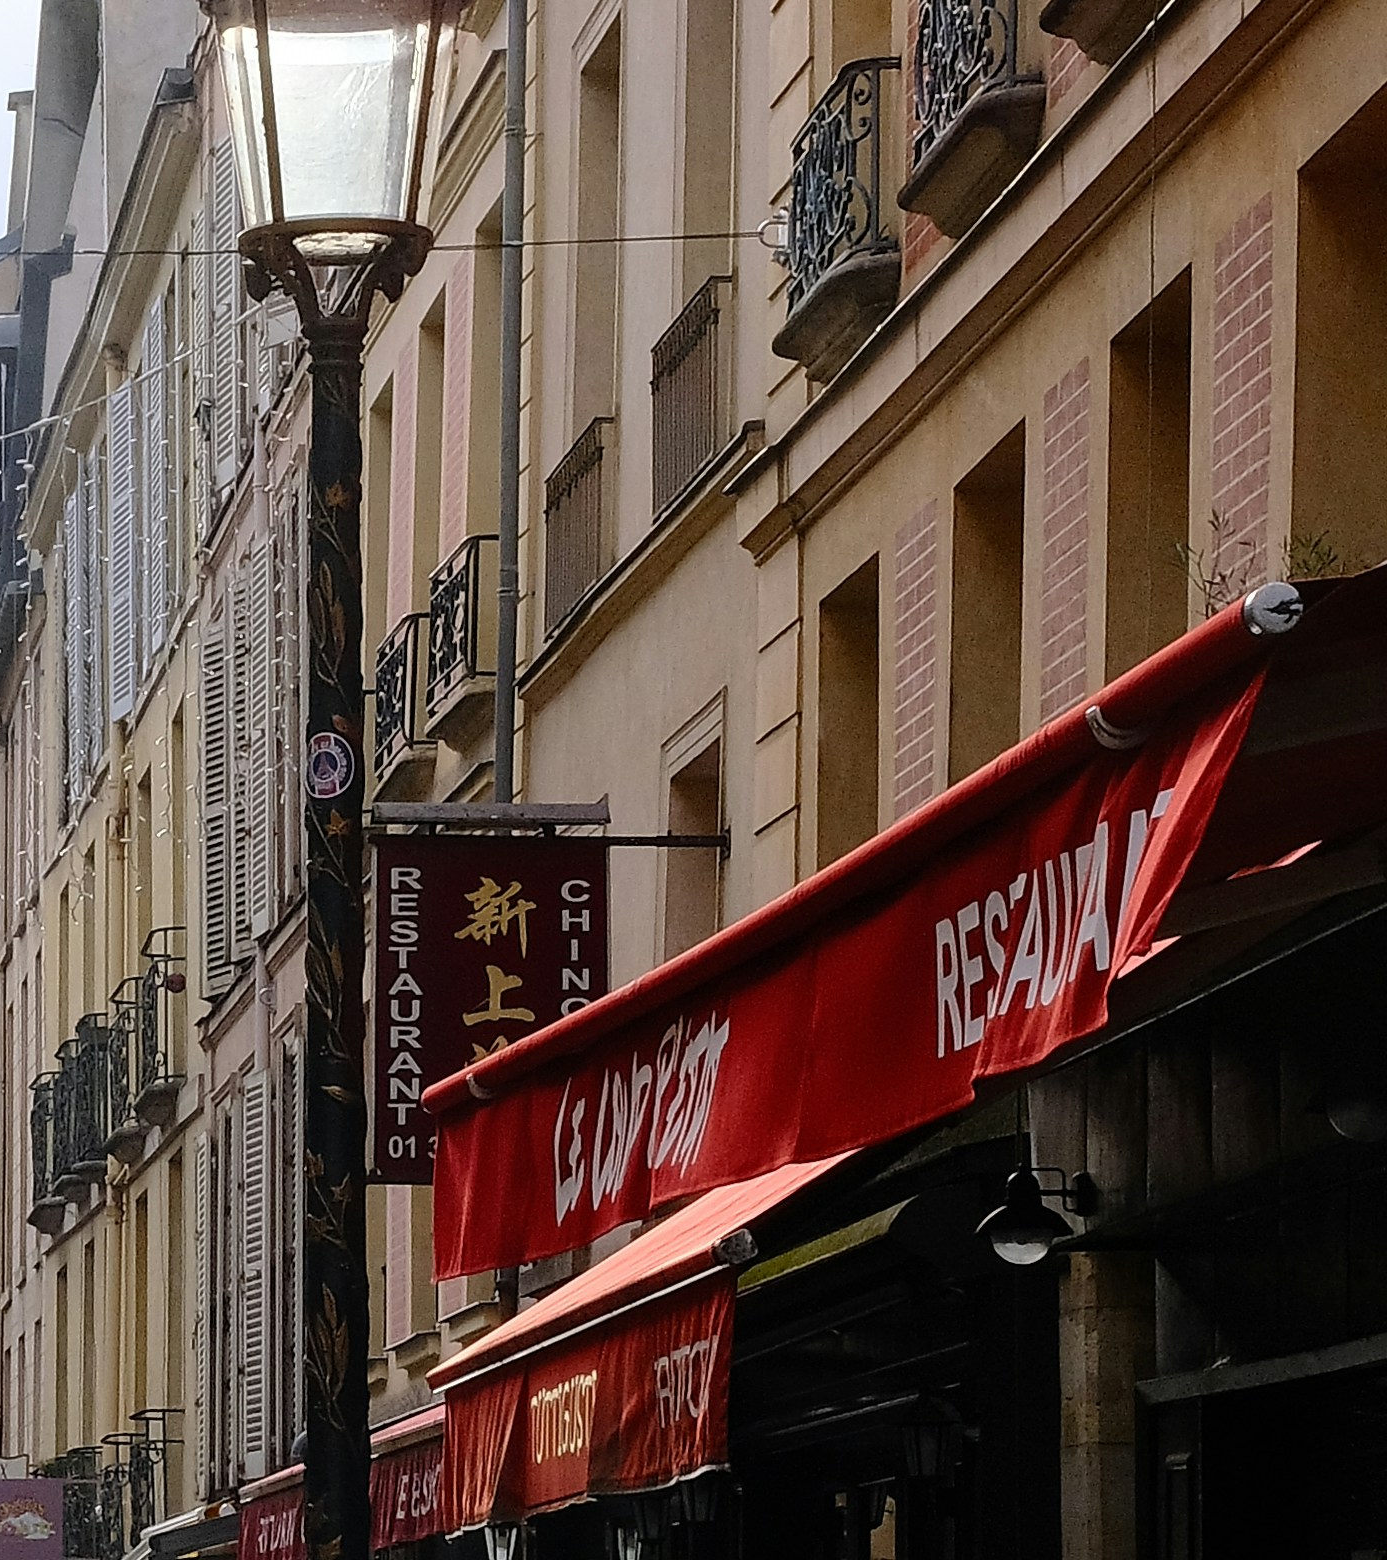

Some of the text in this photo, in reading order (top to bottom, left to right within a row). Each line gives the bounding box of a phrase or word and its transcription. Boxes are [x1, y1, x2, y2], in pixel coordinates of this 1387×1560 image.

[386, 866, 424, 1127] RESTAURANT
[453, 874, 538, 1068] 新上
[387, 1135, 417, 1160] 01
